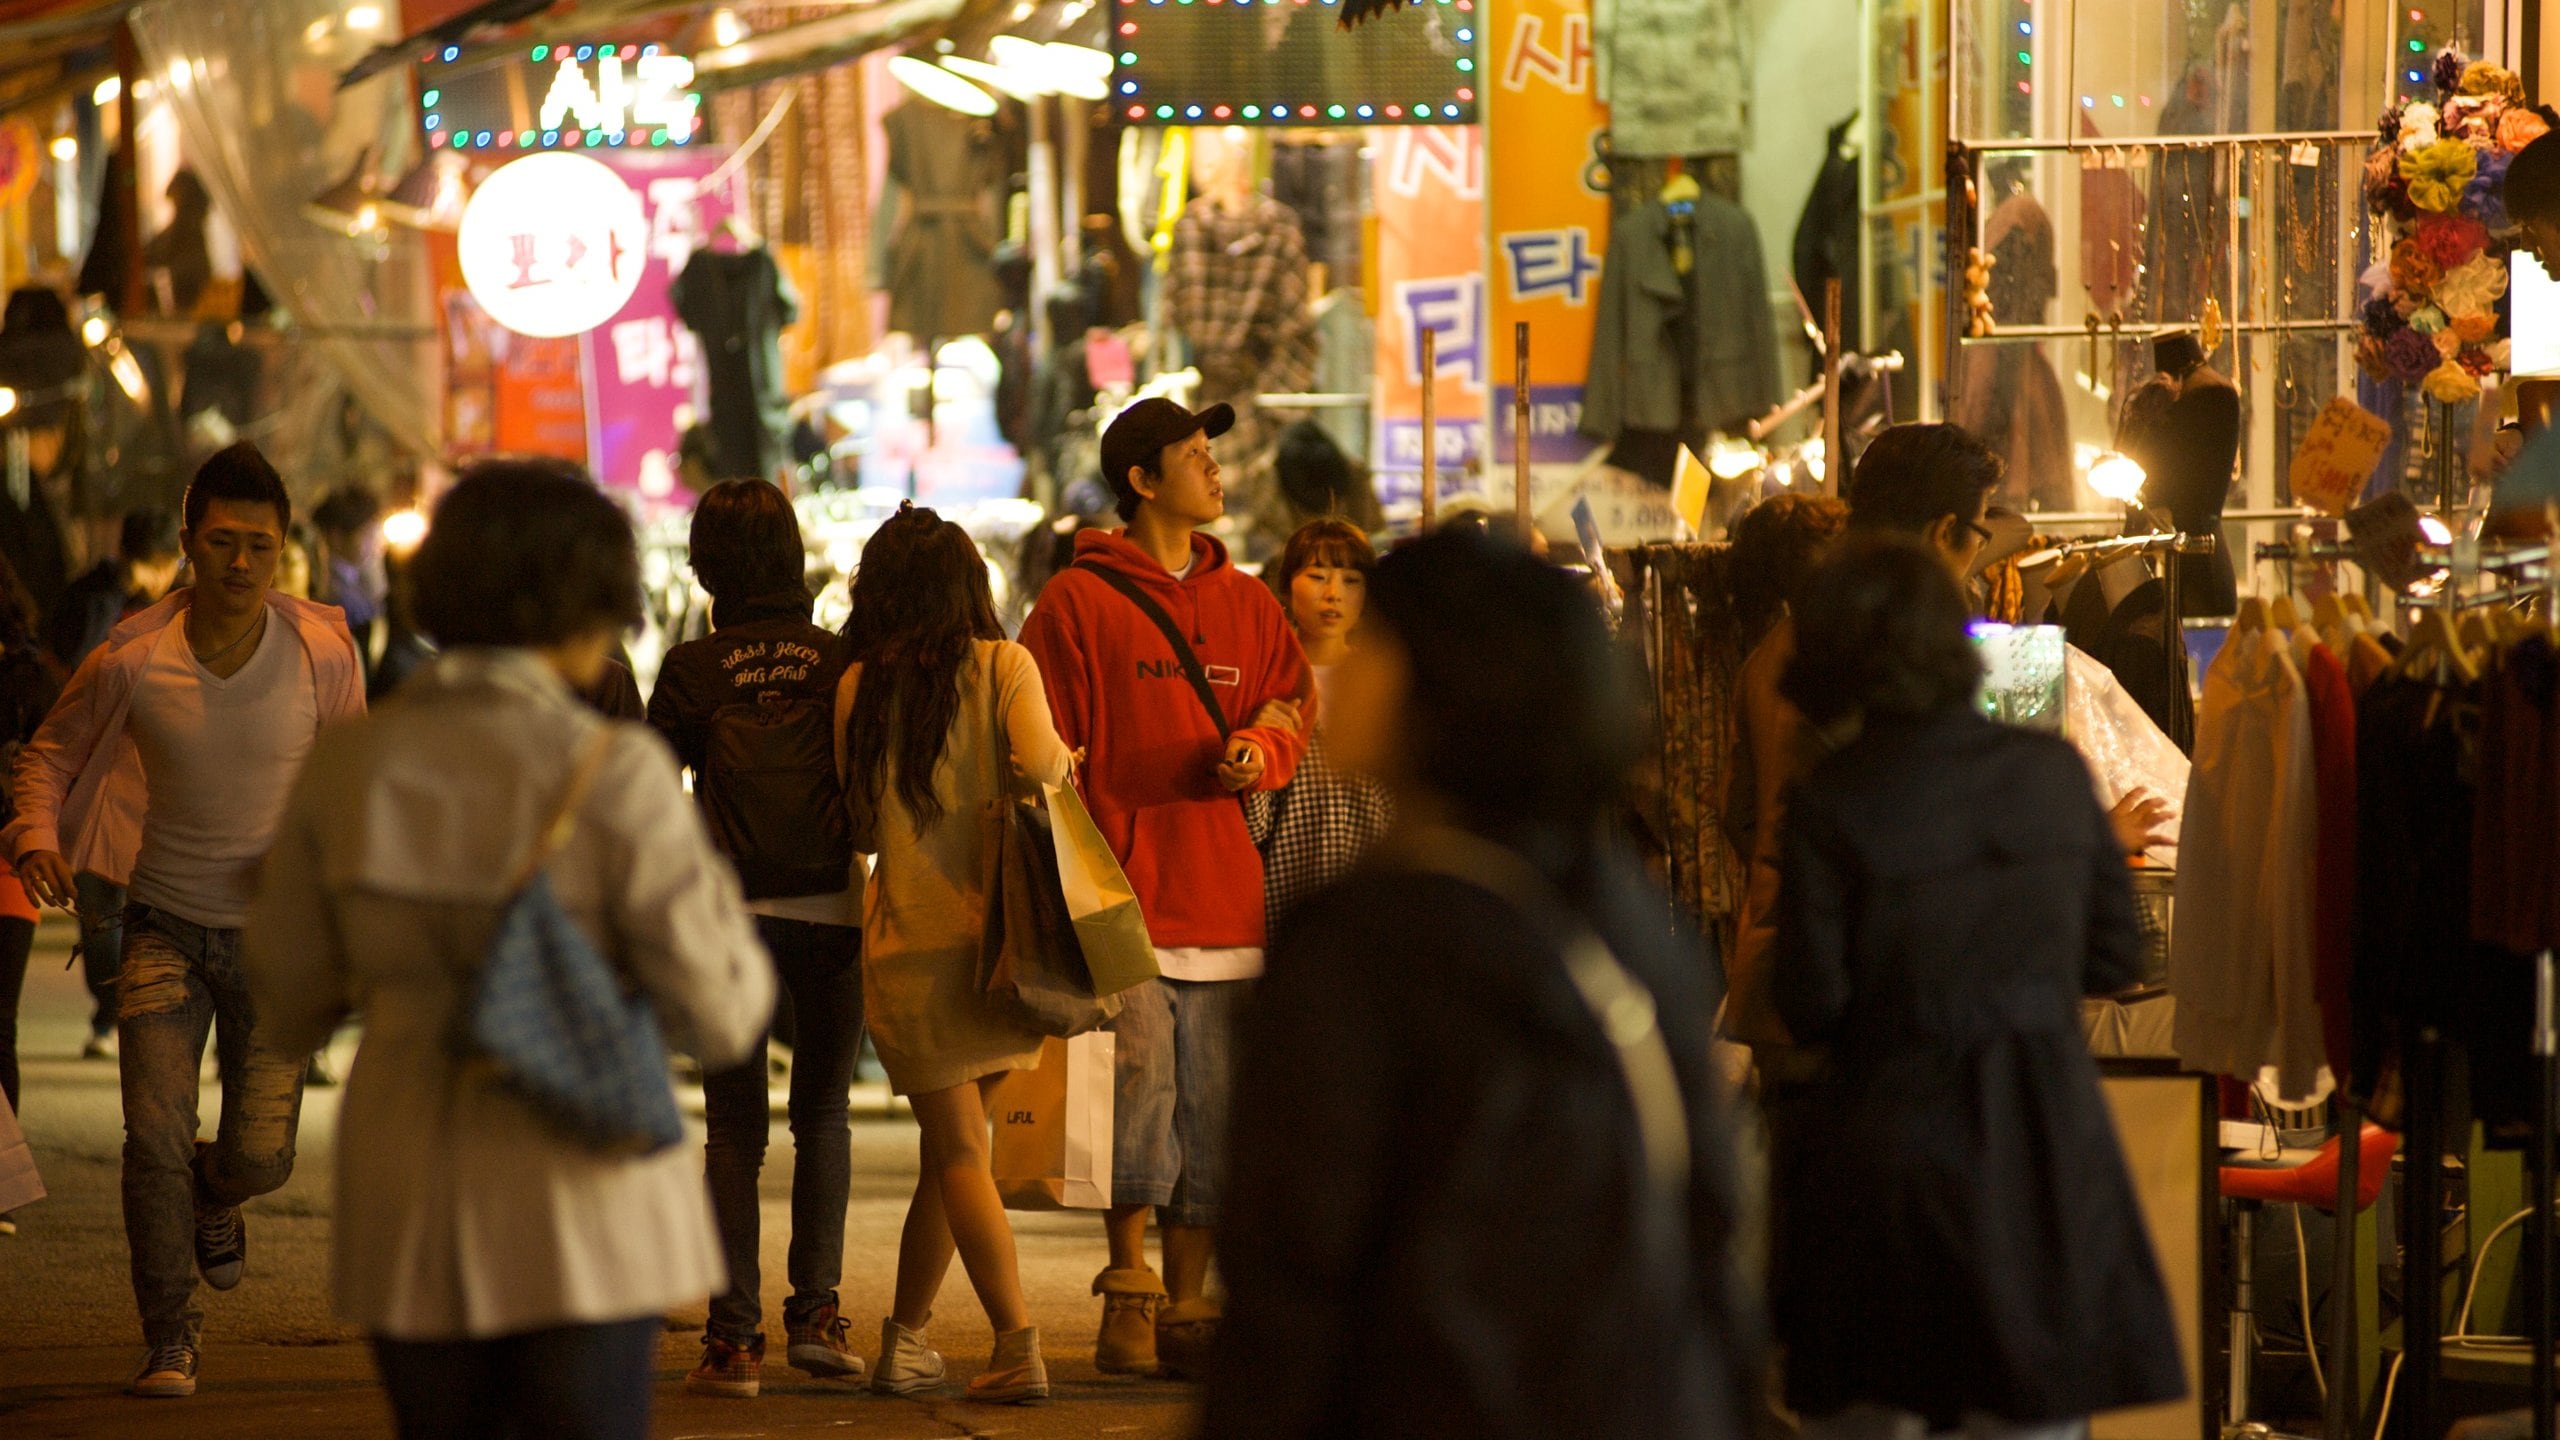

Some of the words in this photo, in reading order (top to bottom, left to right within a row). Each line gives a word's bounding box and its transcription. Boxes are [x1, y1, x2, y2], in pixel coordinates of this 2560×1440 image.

[1502, 227, 1601, 307] 타
[734, 667, 766, 687] girls
[1136, 660, 1193, 680] NIK
